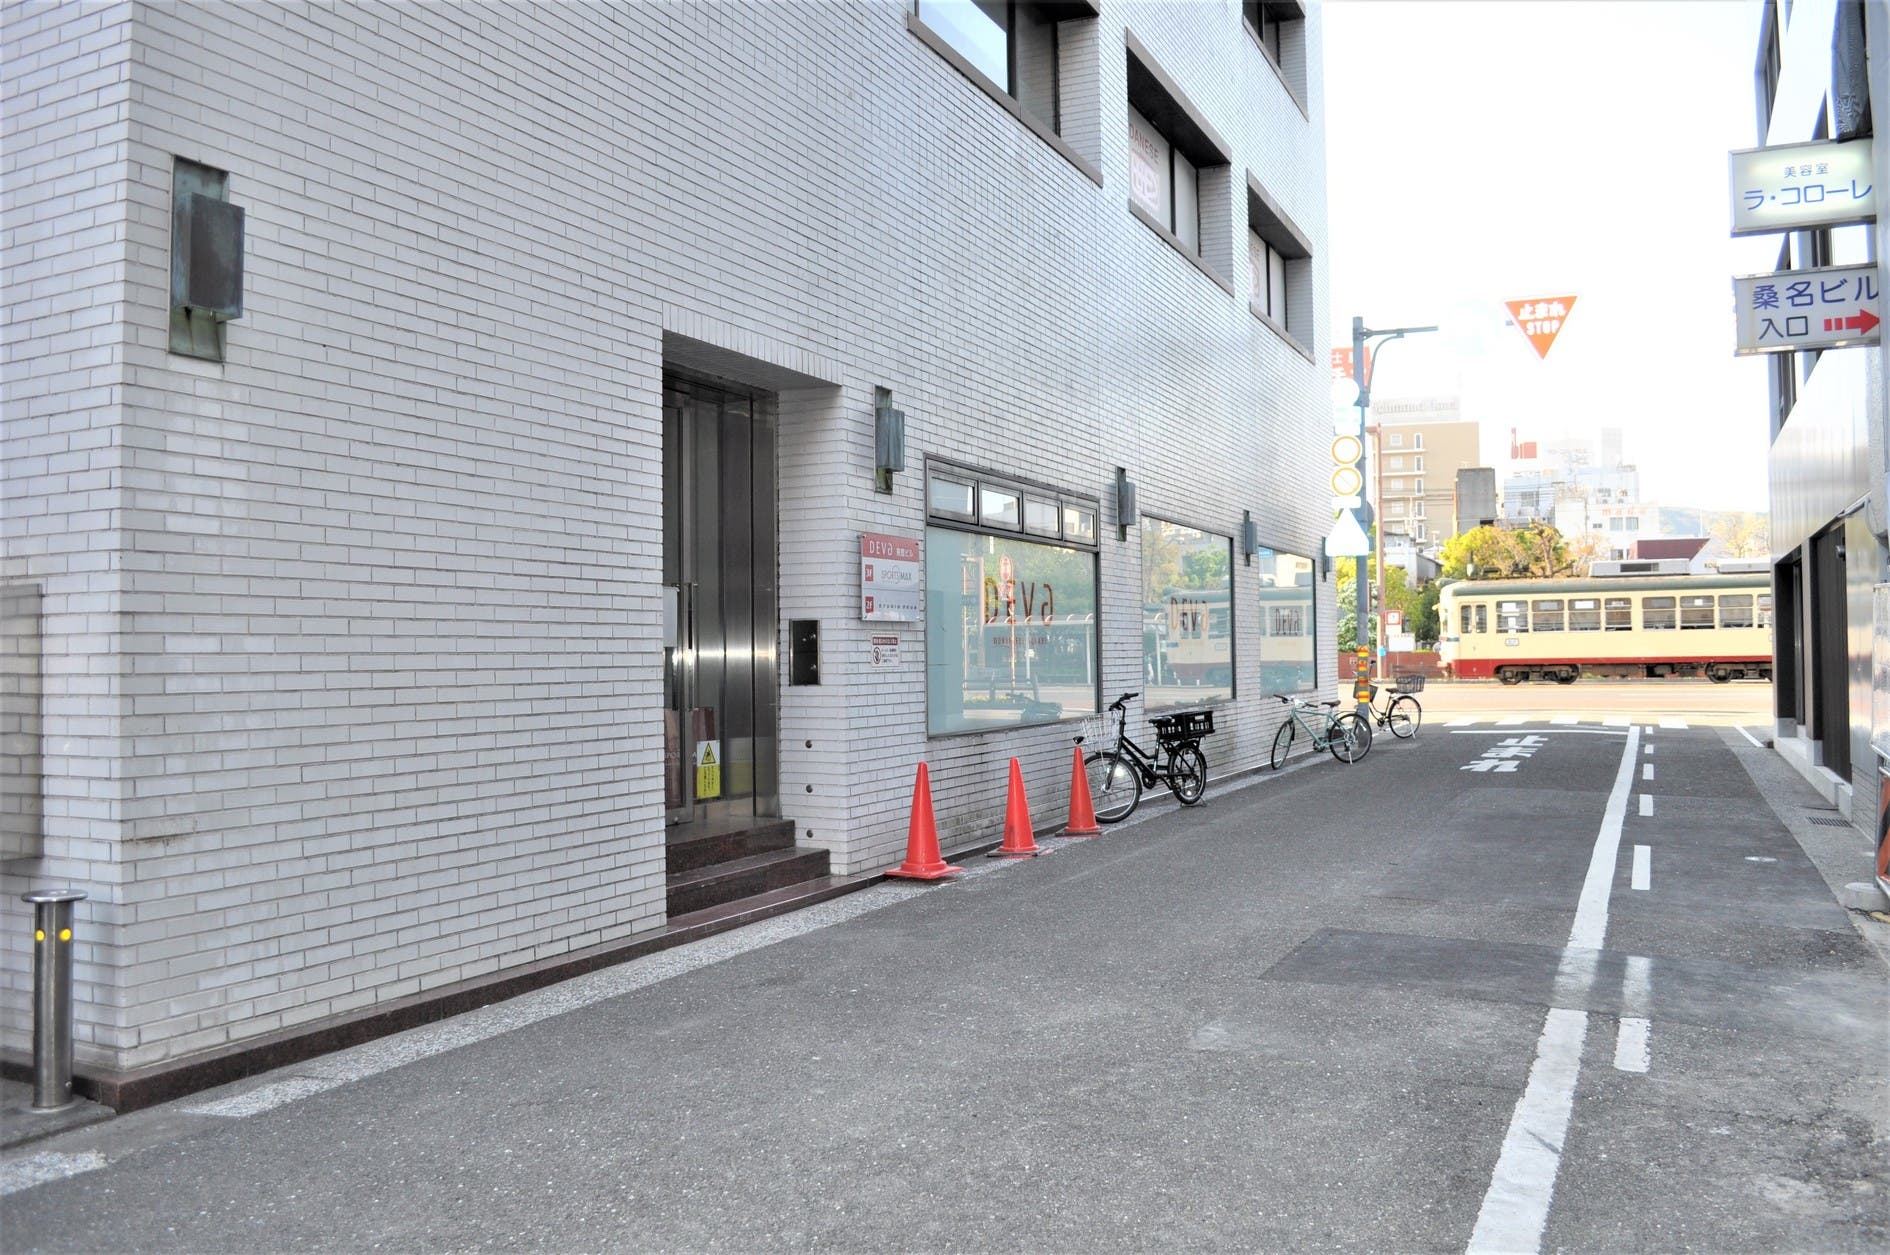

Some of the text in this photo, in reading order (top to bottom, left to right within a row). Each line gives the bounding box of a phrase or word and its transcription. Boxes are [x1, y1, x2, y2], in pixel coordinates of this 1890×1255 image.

[1783, 163, 1829, 179] 美容室
[1743, 179, 1873, 211] ラ・コローレ
[1752, 275, 1880, 310] 桑名ビル
[1518, 301, 1567, 320] 止まれ
[1526, 319, 1560, 336] STOP
[1758, 315, 1809, 340] 入口
